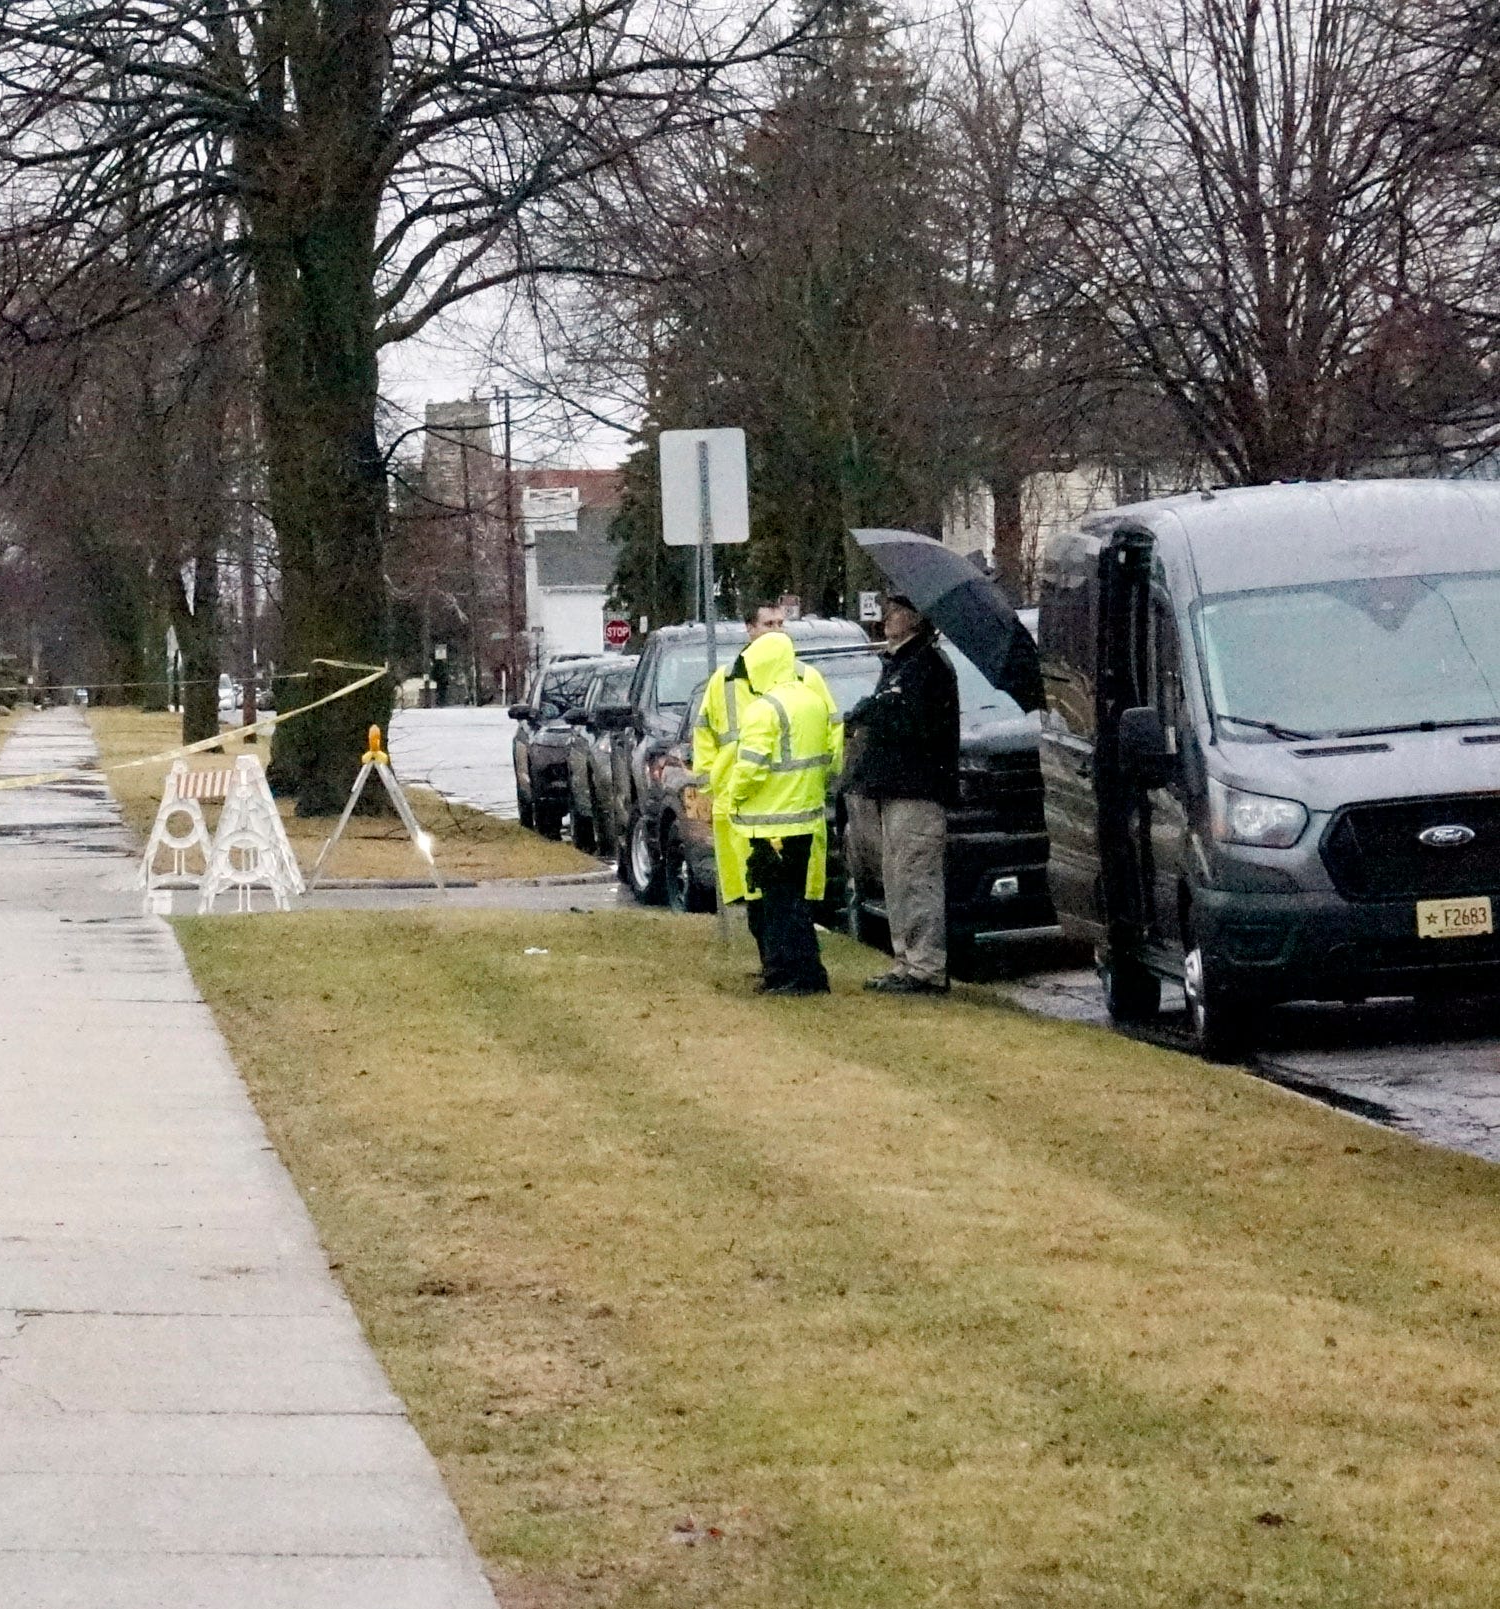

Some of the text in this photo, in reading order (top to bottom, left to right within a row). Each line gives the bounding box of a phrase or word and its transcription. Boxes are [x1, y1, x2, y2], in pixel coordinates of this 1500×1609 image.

[606, 626, 629, 638] STOP
[1432, 829, 1463, 842] Ford
[1444, 906, 1488, 927] F2683
